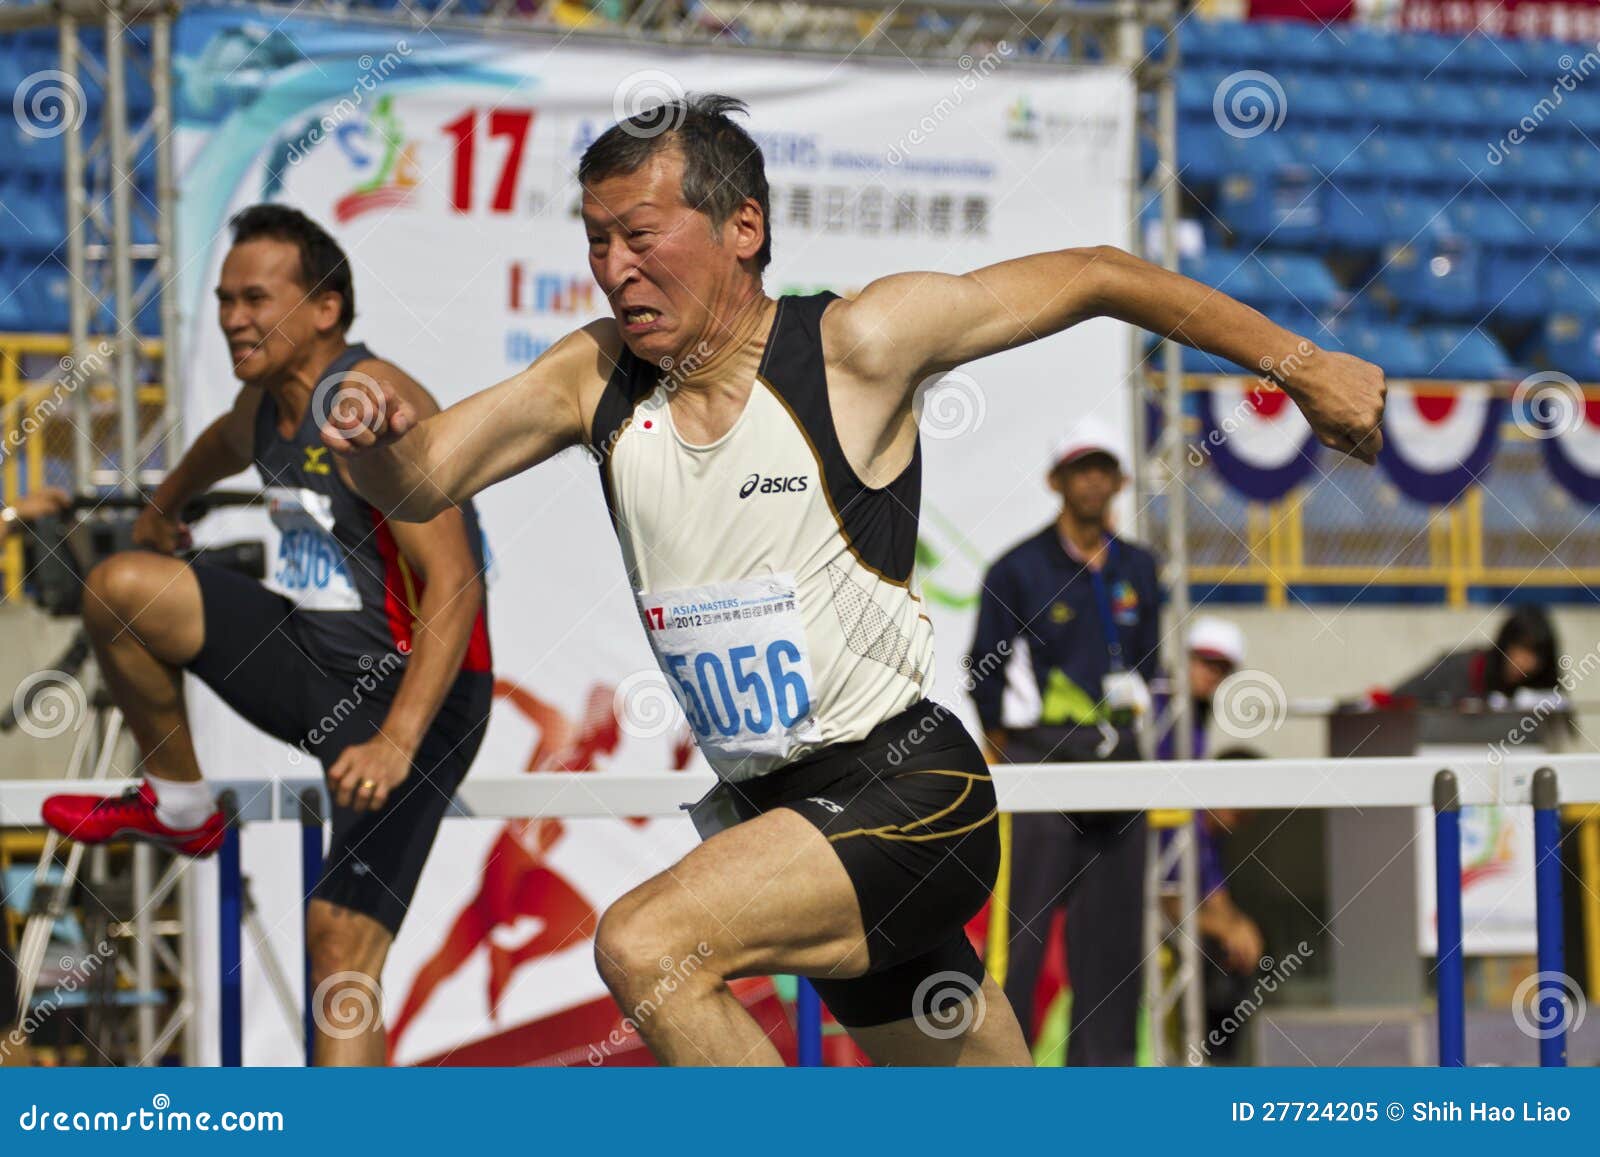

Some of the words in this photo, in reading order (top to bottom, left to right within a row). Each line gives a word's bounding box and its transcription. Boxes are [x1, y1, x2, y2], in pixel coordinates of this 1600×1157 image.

[440, 107, 536, 215] 17
[760, 476, 807, 493] asics
[645, 607, 666, 631] 17
[673, 604, 698, 616] ASIA
[699, 598, 739, 612] MASTERS
[665, 640, 810, 737] 5056
